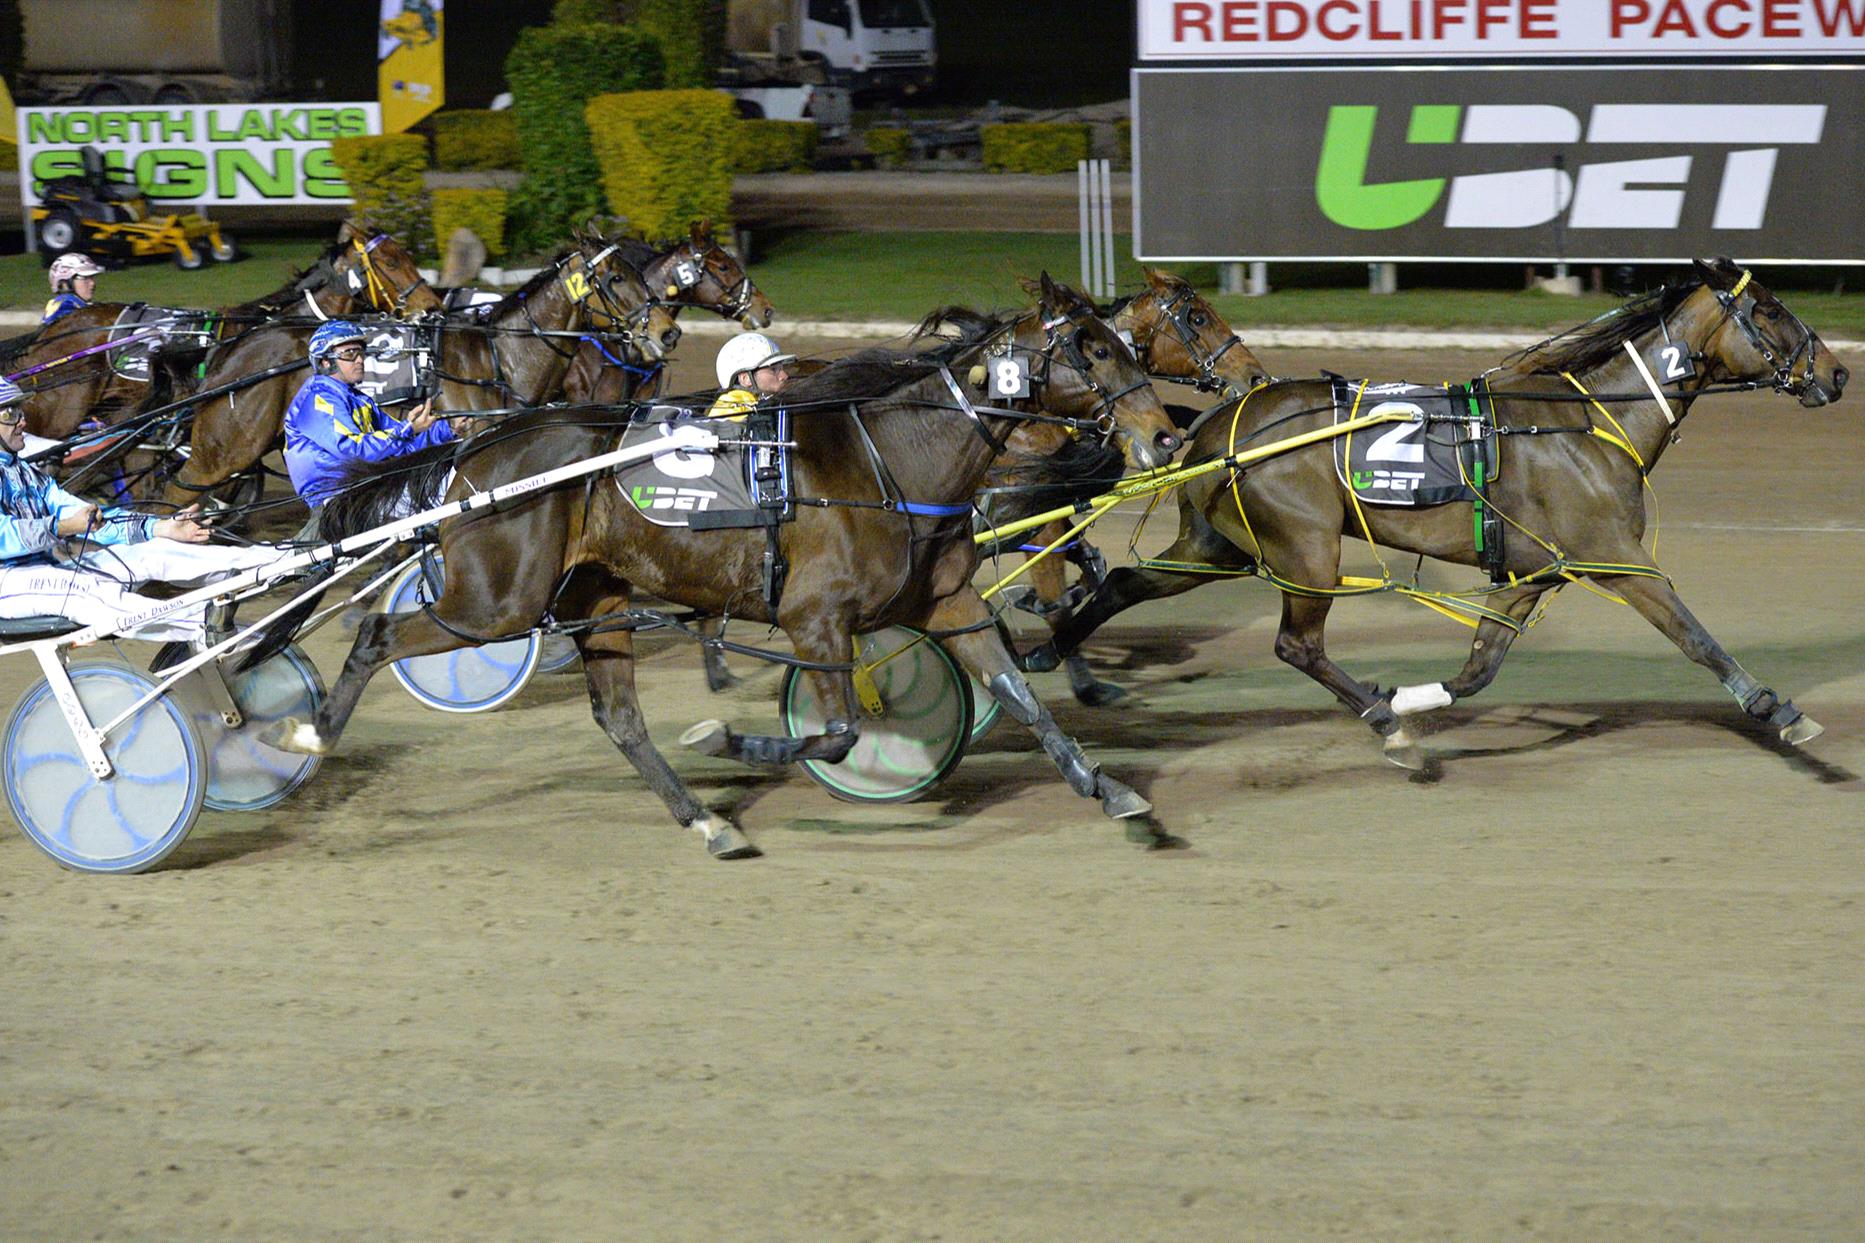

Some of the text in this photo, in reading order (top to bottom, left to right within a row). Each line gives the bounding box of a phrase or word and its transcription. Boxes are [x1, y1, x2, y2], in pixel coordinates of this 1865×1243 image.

[1172, 0, 1558, 42] REDCLIFFE
[30, 107, 367, 144] NORTH LAKES
[1315, 104, 1828, 231] UBET
[565, 272, 590, 301] 12
[677, 263, 695, 285] 5
[997, 360, 1021, 395] 8
[1661, 346, 1686, 379] 2
[1366, 401, 1425, 463] 2
[1352, 470, 1426, 490] UBET
[632, 485, 718, 511] UBET
